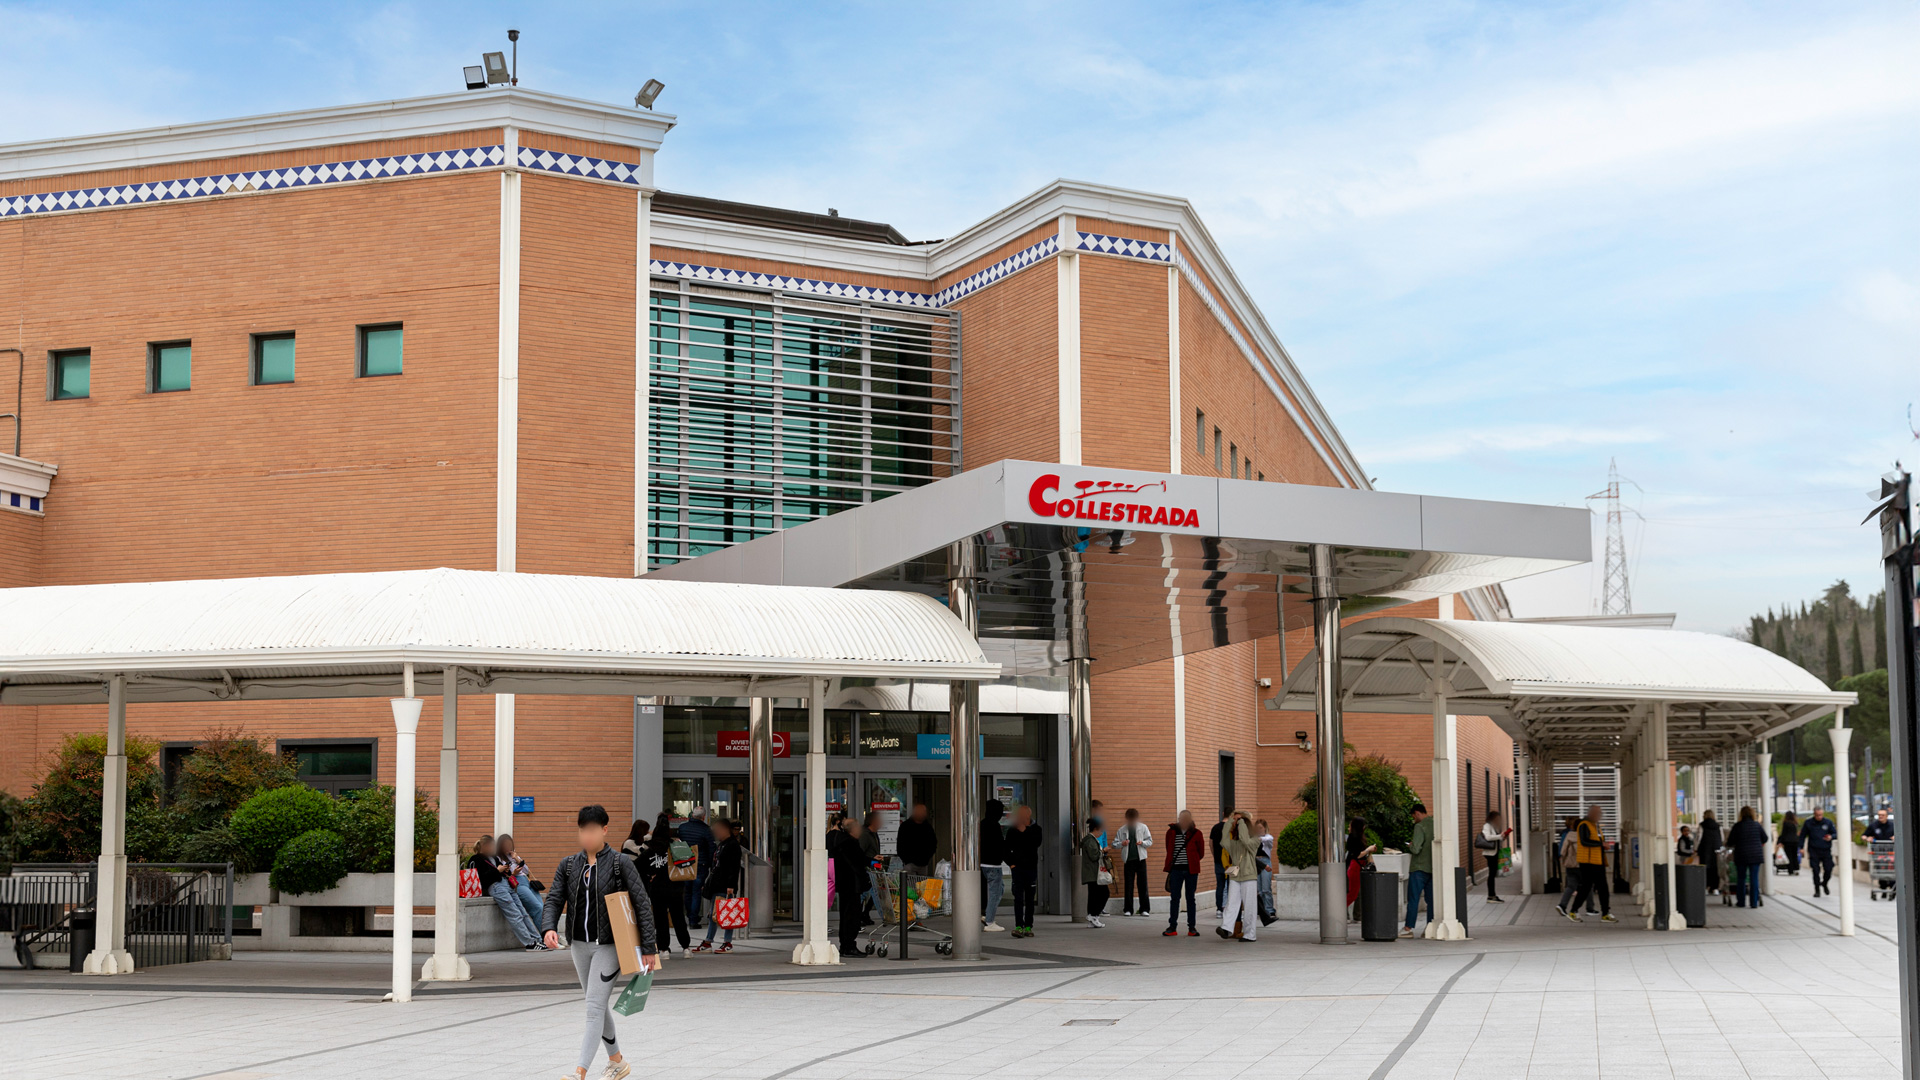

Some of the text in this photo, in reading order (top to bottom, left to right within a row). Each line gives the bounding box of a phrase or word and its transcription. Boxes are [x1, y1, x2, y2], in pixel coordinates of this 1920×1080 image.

[1028, 473, 1200, 528] COLLESTRADA
[881, 736, 900, 748] Jeans
[931, 747, 951, 755] INGR
